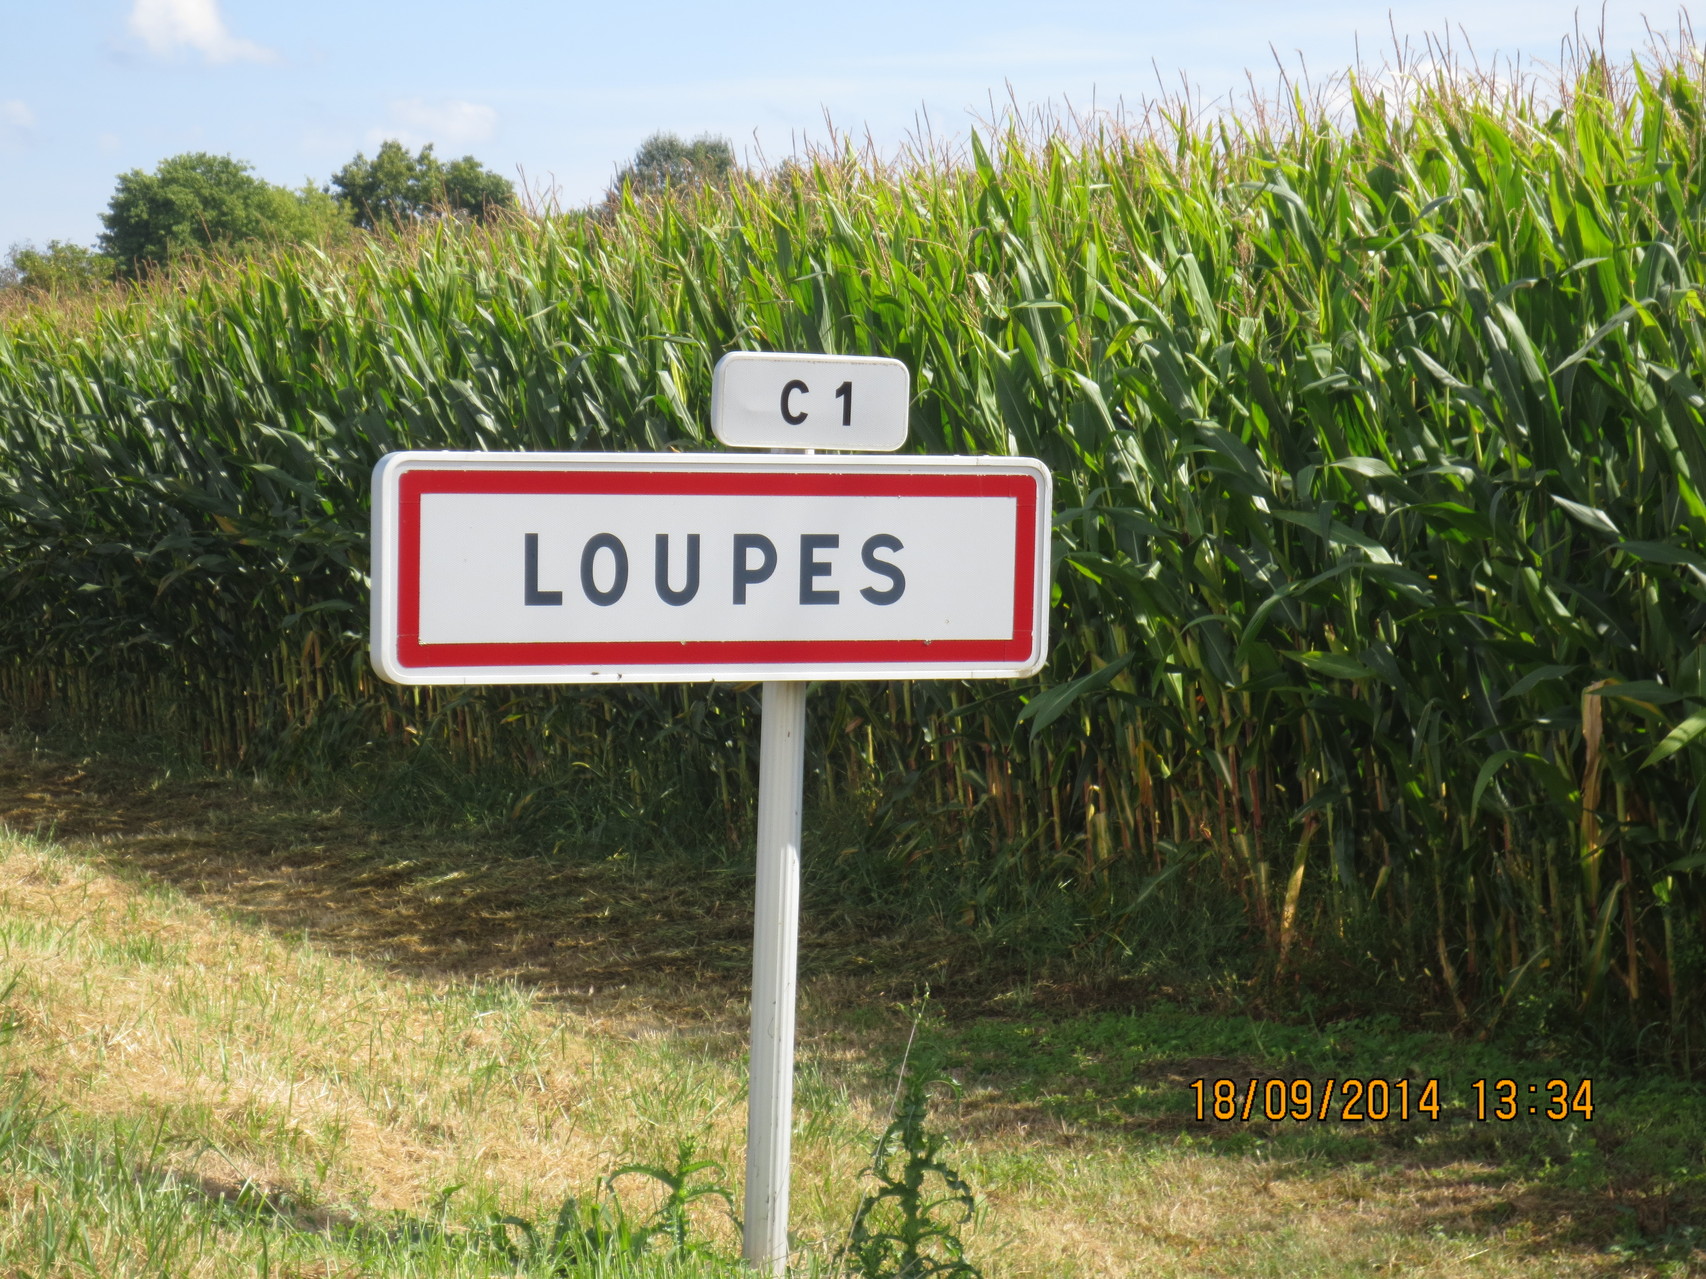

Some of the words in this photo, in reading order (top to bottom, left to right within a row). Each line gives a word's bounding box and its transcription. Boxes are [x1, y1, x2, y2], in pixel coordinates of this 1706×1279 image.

[780, 379, 810, 426] C
[834, 381, 853, 427] 1
[524, 532, 906, 607] LOUPES
